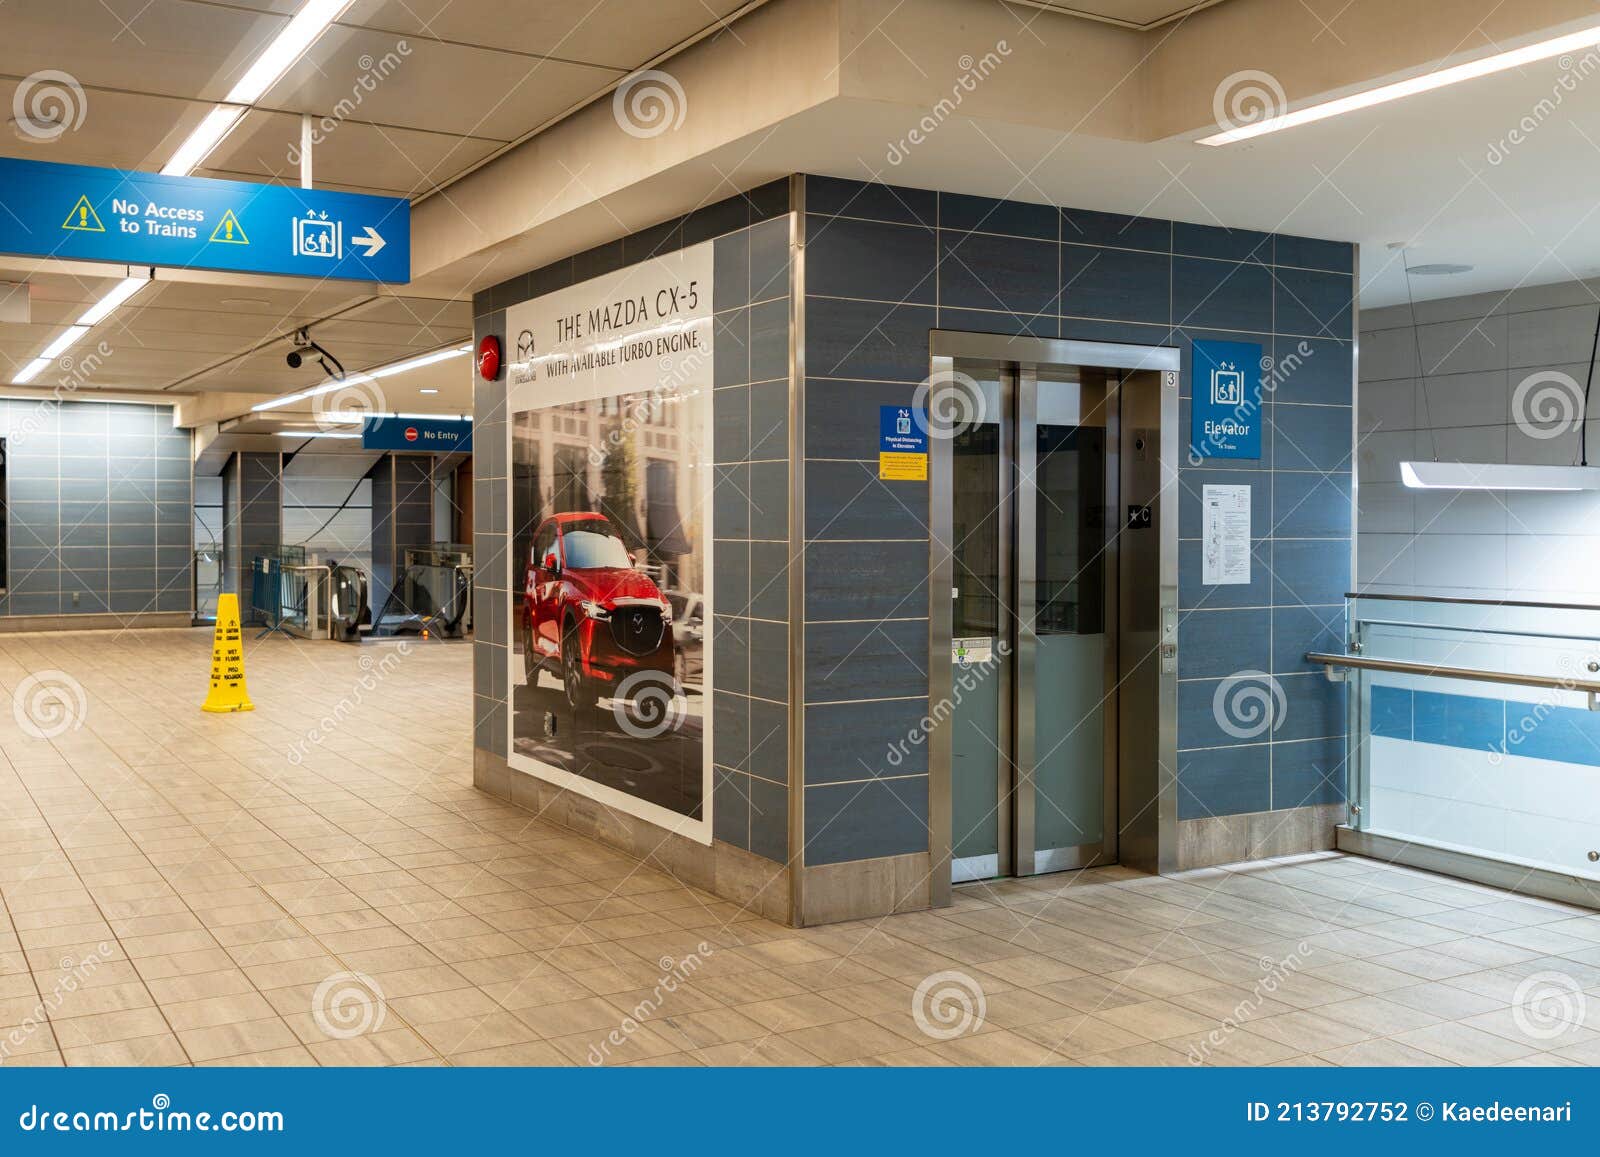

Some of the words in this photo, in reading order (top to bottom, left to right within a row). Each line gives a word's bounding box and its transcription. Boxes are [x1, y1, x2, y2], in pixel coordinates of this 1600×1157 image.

[112, 199, 139, 215] No
[145, 202, 204, 221] Access
[120, 218, 140, 233] to
[145, 220, 197, 239] Trains
[557, 314, 582, 342] THE
[588, 296, 648, 334] MAZDA
[656, 281, 698, 317] CX-5
[547, 360, 569, 378] WITH
[571, 351, 616, 374] AVAILABLE
[619, 341, 653, 363] TURBO
[657, 330, 701, 355] ENGINE.
[1167, 372, 1175, 385] 3
[424, 431, 436, 439] No
[438, 431, 459, 441] Entry
[1204, 420, 1250, 436] Elevator
